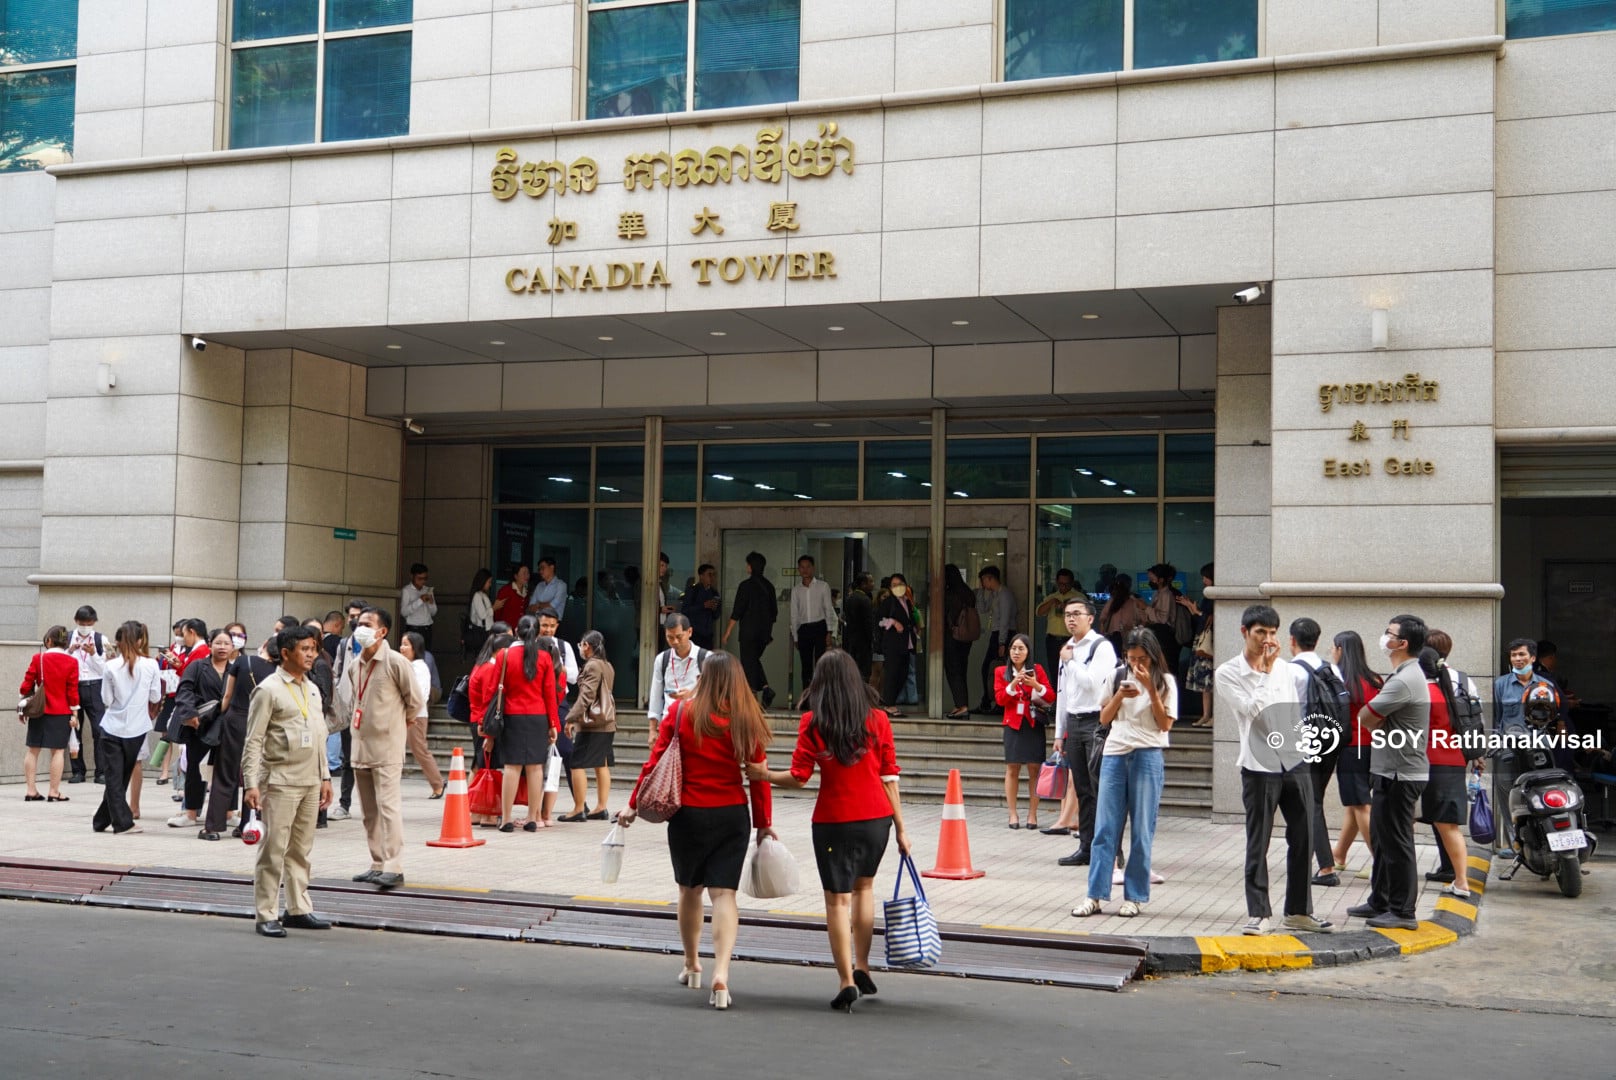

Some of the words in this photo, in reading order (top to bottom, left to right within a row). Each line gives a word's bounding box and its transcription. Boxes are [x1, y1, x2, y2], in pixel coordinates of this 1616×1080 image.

[490, 147, 599, 200] វិមាន
[504, 261, 671, 293] CANADIA
[691, 251, 837, 283] TOWER
[1324, 459, 1370, 477] East
[1384, 458, 1435, 475] Gate
